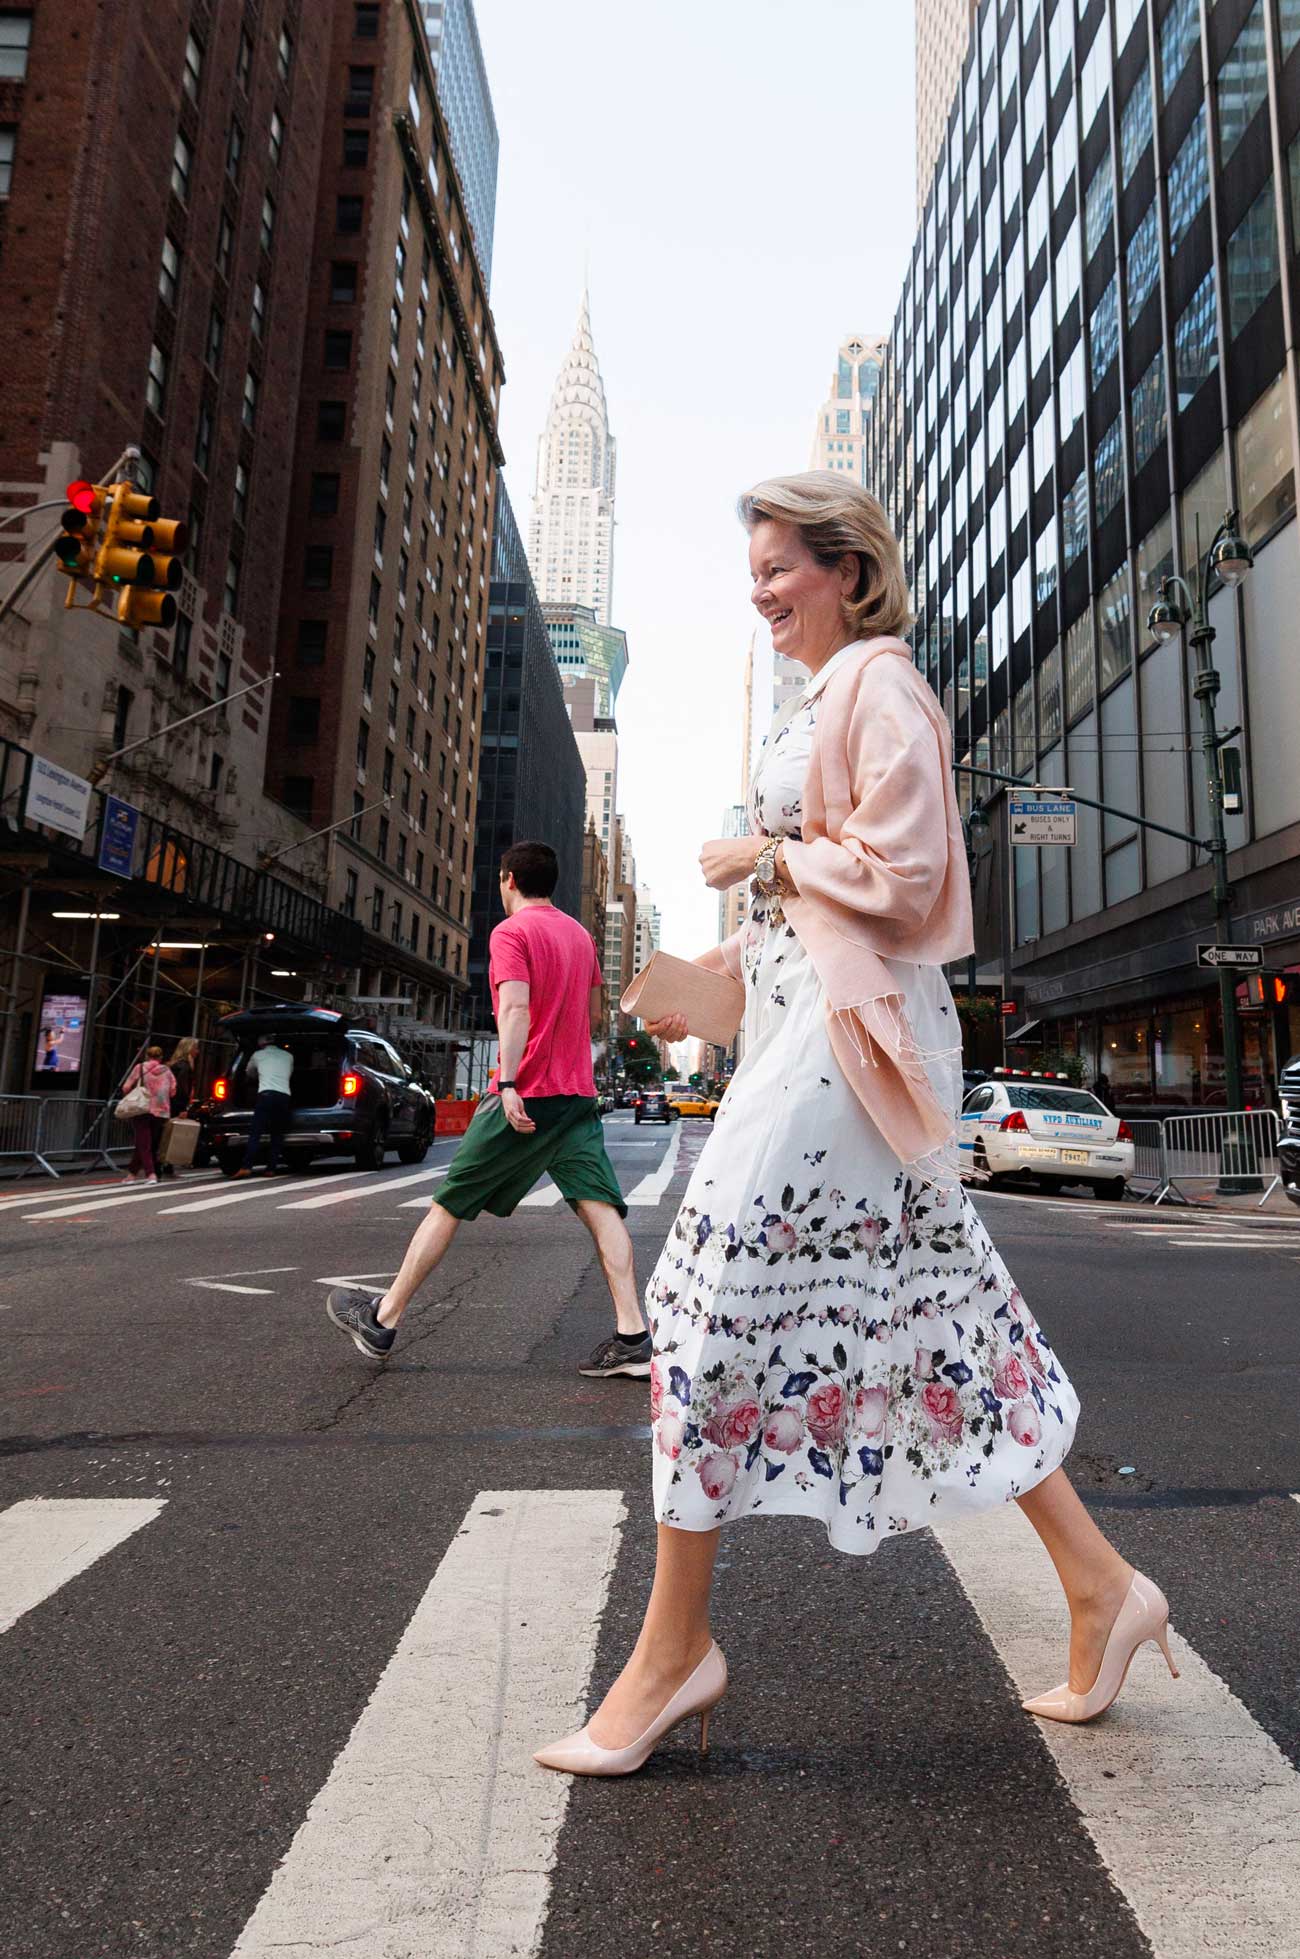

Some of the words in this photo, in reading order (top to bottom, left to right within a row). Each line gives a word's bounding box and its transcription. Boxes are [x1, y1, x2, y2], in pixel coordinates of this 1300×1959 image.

[1254, 914, 1280, 938] PARK
[1208, 951, 1227, 960] ONE
[1235, 952, 1255, 961] WAY
[1043, 1114, 1063, 1124] NYPD
[1066, 1116, 1103, 1129] AUXILIARY
